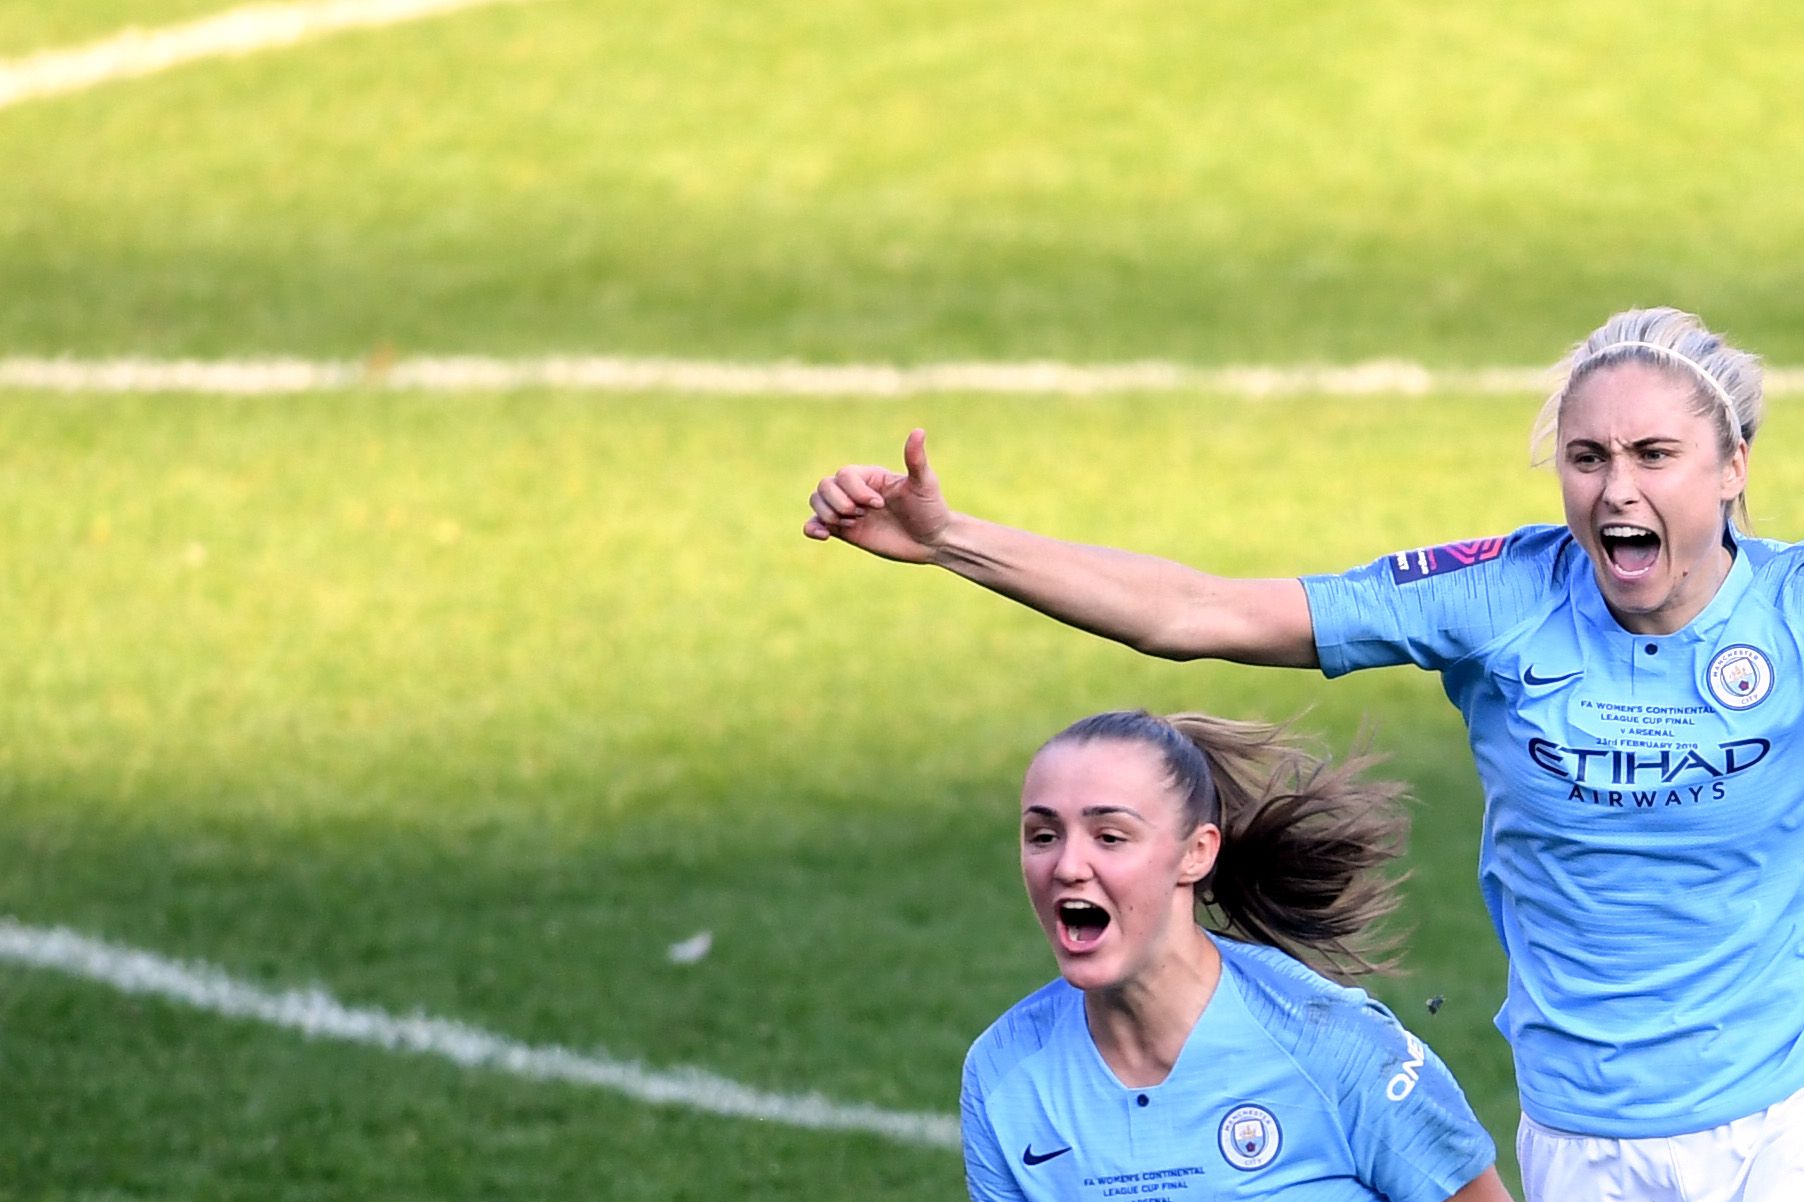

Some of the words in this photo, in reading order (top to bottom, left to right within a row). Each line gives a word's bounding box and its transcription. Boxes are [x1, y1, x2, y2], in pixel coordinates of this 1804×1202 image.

[1580, 700, 1593, 708] FA
[1596, 702, 1643, 713] WOMEN'S
[1645, 705, 1716, 715] CONTINENTAL
[1600, 713, 1639, 724] LEAGUE
[1642, 716, 1662, 725] CUP
[1665, 717, 1695, 726] FINAL
[1628, 727, 1675, 738] ARSENAL
[1620, 739, 1673, 750] FEBRUARY
[1528, 737, 1771, 785] ETIHAD
[1568, 781, 1725, 808] AIRWAYS
[1142, 1166, 1205, 1181] CONTINENTAL
[1103, 1185, 1139, 1197] LEAGUE
[1141, 1183, 1159, 1193] CUP
[1161, 1181, 1189, 1190] FINAL
